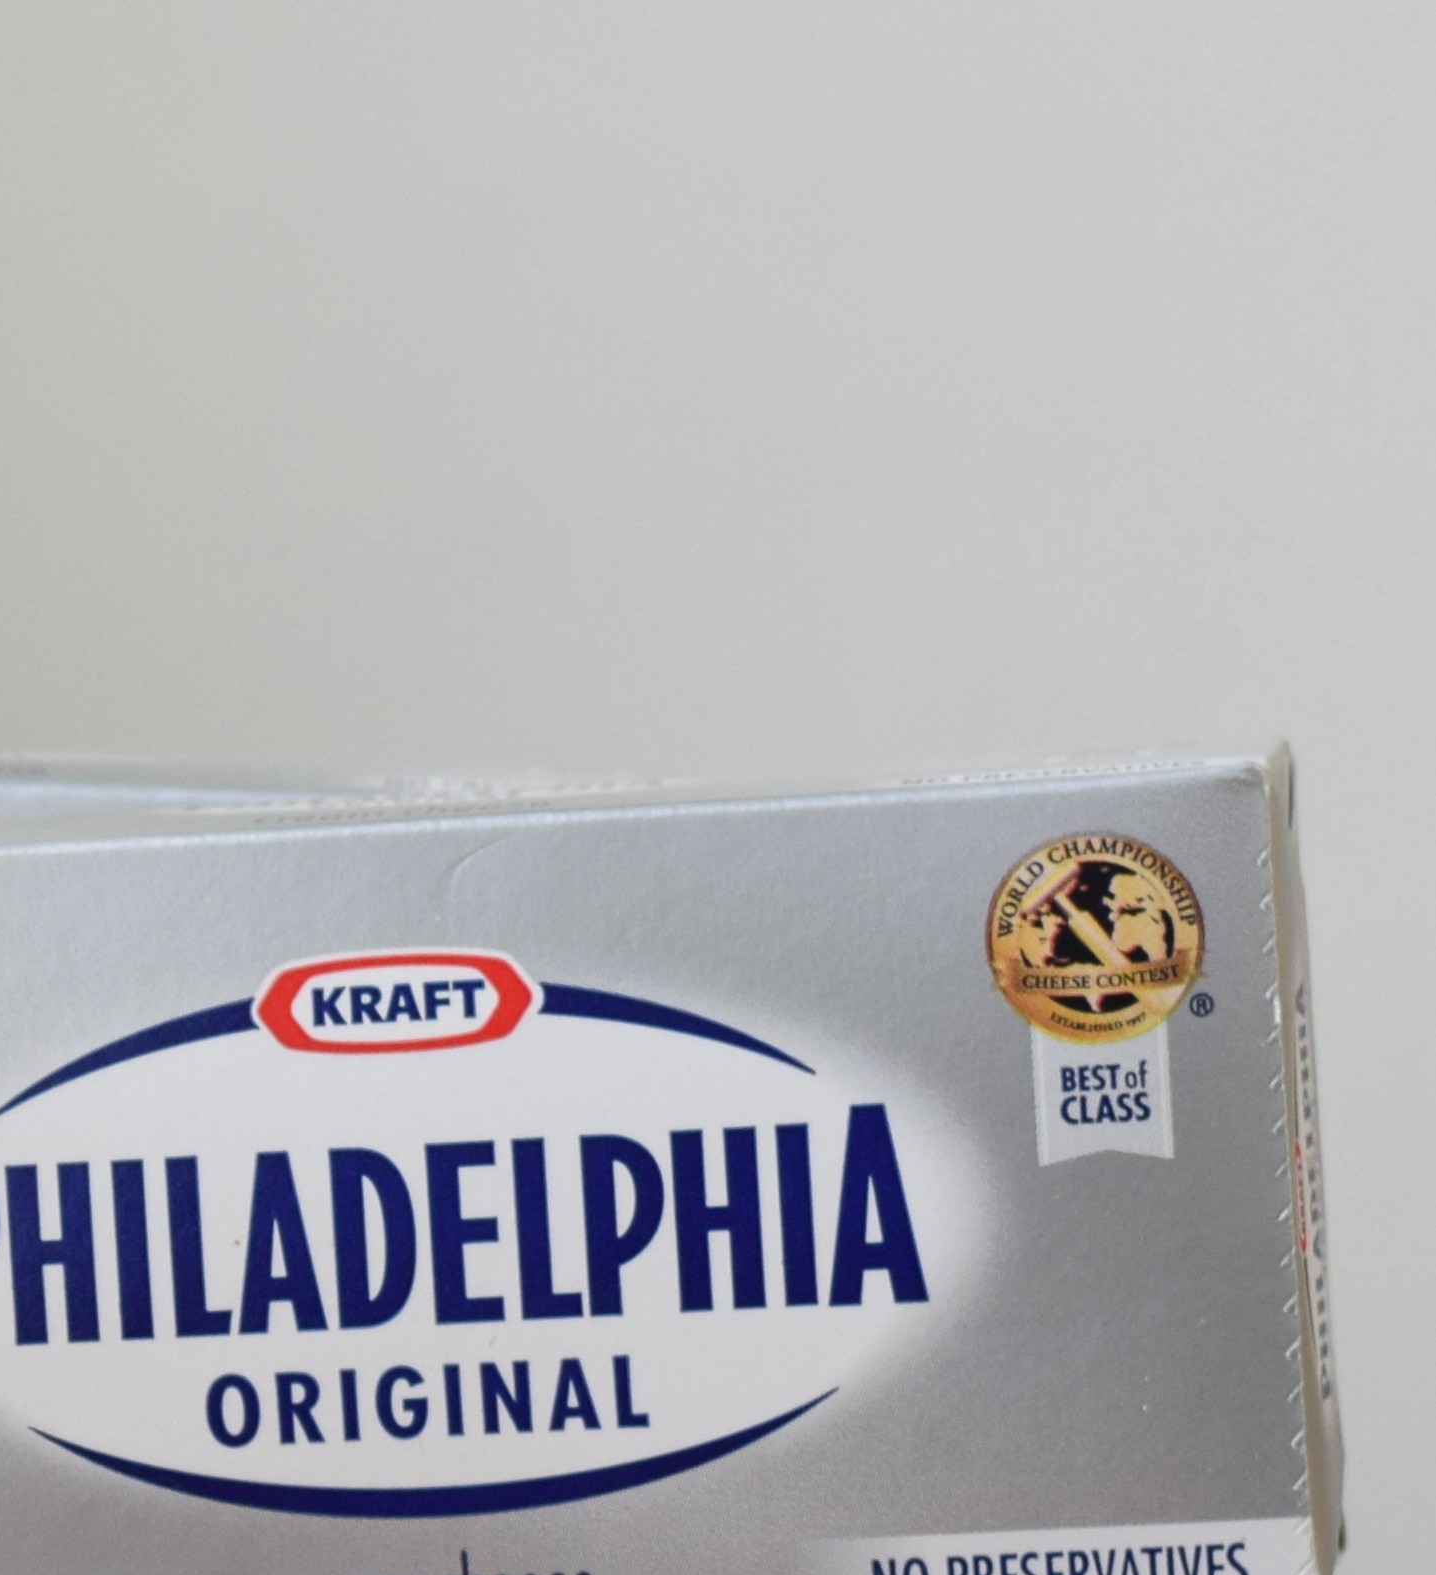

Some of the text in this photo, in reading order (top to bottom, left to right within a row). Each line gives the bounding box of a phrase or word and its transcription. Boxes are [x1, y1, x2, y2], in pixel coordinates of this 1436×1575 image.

[997, 838, 1197, 938] WORLD CHAMPIONSHIP
[1022, 963, 1181, 990] CHEESE CONTEST
[311, 978, 485, 1027] KRAFT
[1061, 1059, 1147, 1092] BEST of
[1060, 1092, 1151, 1125] CLASS
[204, 1353, 650, 1447] ORIGINAL
